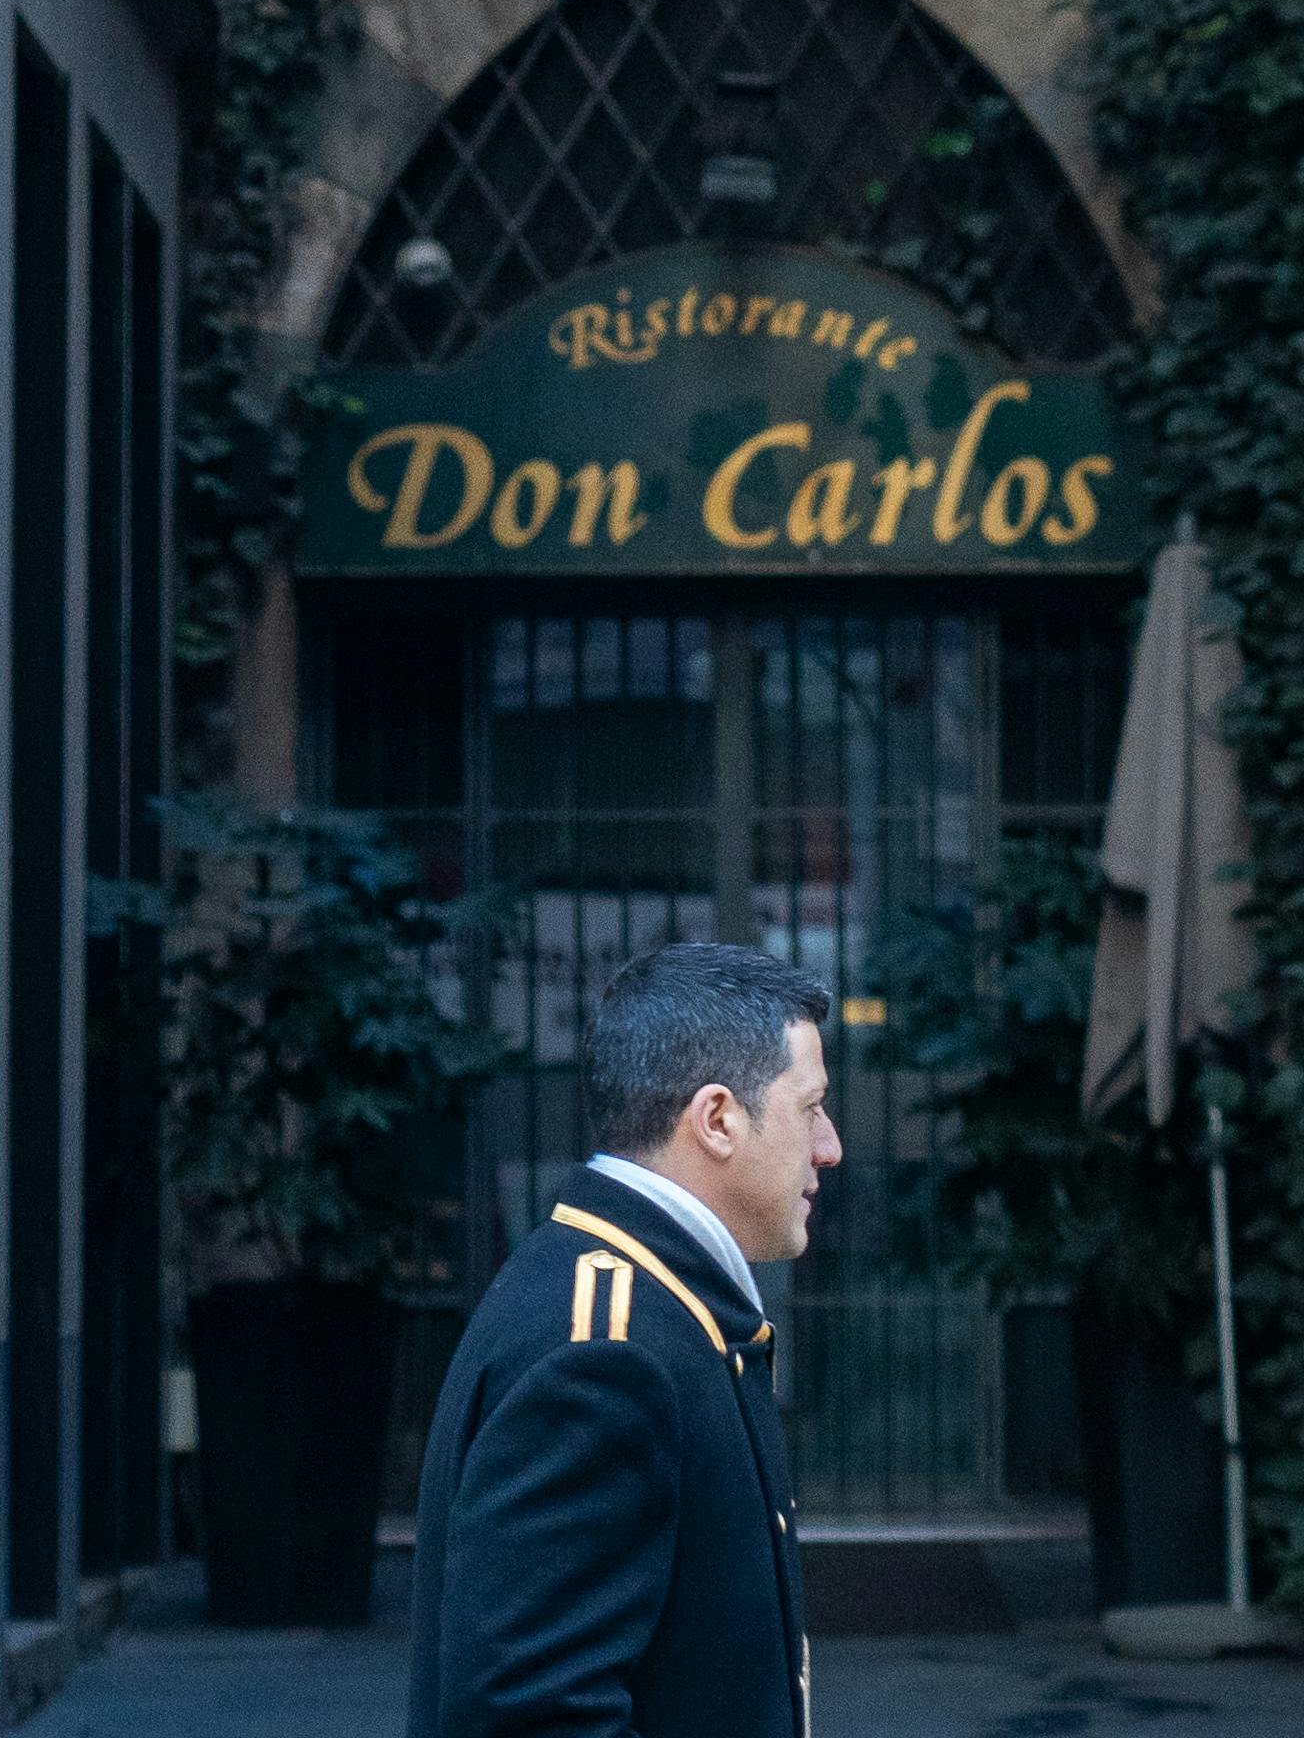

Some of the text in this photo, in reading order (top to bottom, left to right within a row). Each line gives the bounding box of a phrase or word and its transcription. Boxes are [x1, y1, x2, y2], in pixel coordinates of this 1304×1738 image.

[548, 285, 918, 370] Ristorante
[347, 380, 1113, 549] Don Carlos
